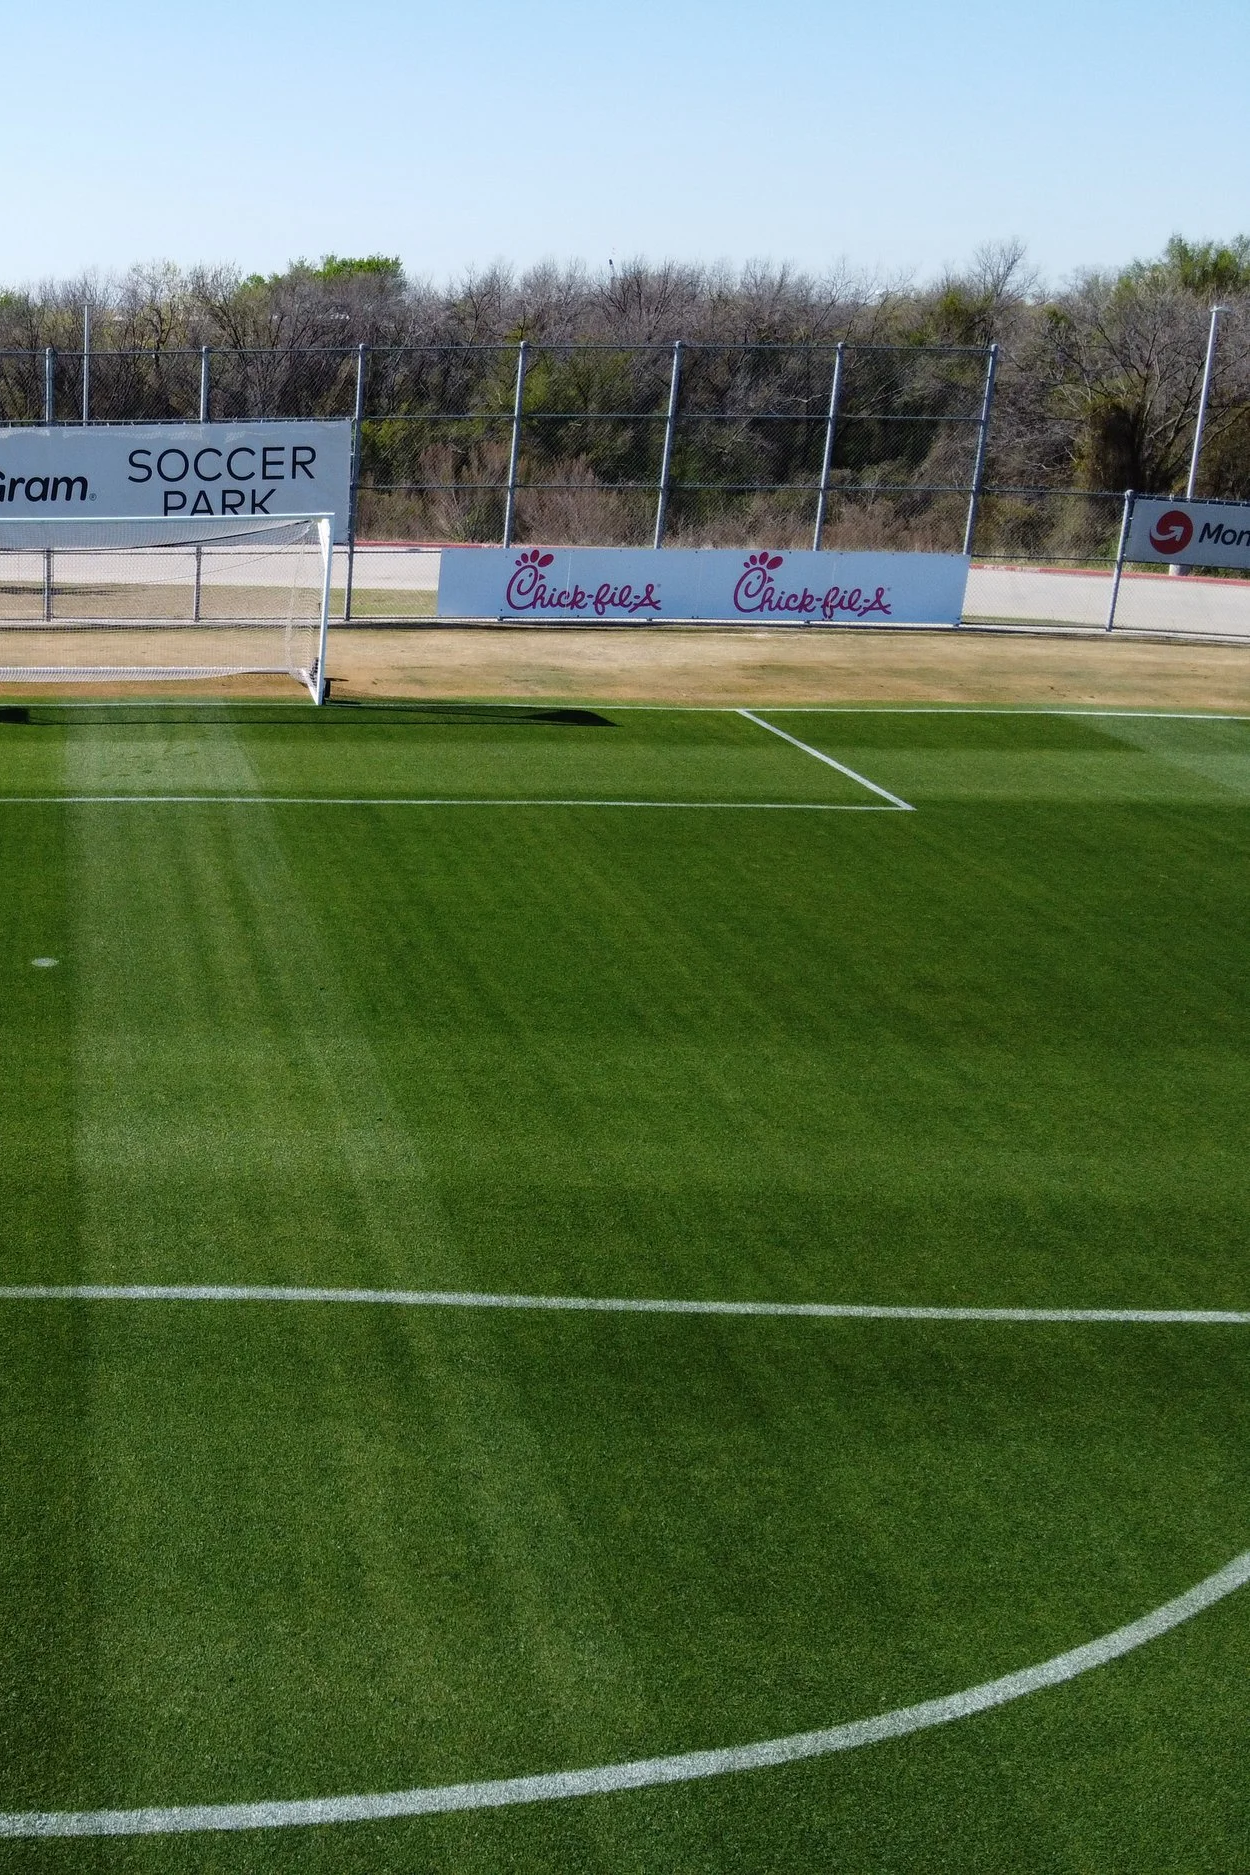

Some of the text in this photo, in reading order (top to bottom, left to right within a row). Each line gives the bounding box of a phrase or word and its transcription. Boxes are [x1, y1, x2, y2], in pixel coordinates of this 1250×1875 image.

[128, 446, 317, 483] SOCCER
[163, 488, 277, 516] PARK
[506, 564, 662, 616] Chick-fil-A
[733, 566, 892, 619] Chick-fil-A
